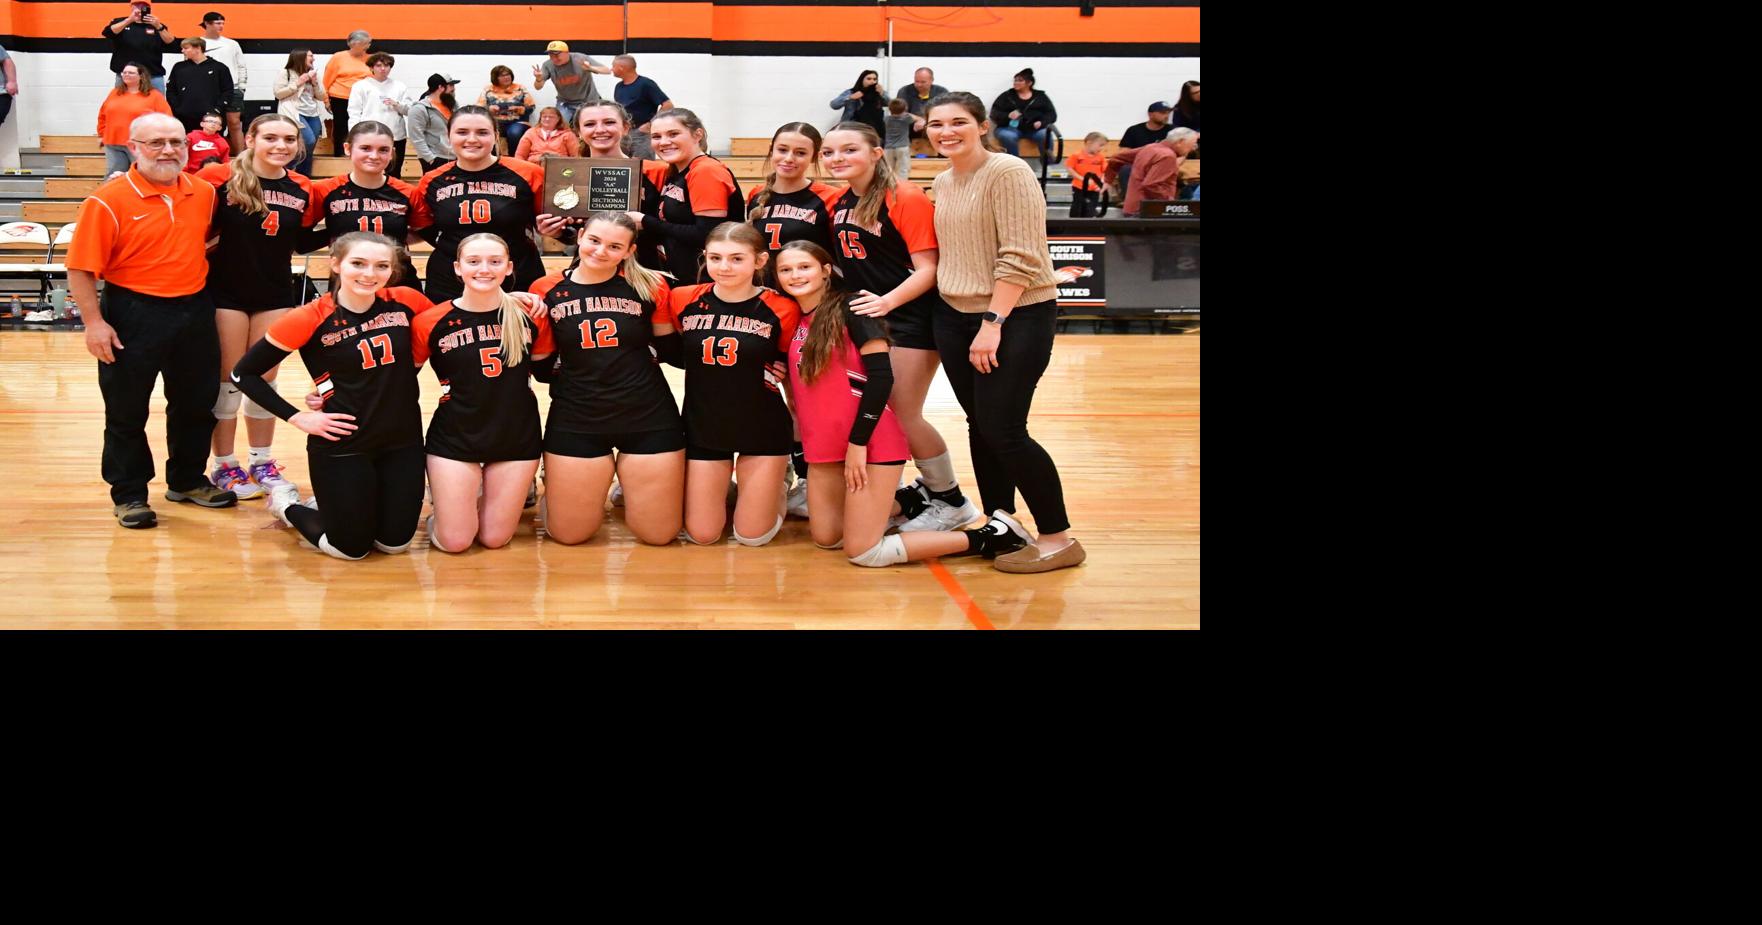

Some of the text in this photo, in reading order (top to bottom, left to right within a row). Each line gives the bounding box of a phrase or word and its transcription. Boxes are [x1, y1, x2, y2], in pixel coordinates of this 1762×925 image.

[436, 181, 517, 202] SOUTH HARRISON
[330, 198, 359, 215] SOUTH
[458, 199, 491, 225] 10
[261, 211, 280, 236] 4
[357, 215, 384, 235] 11
[765, 223, 783, 250] 7
[838, 230, 867, 259] 15
[1049, 245, 1084, 253] SOUTH
[1050, 253, 1093, 261] ARRISON
[1056, 288, 1091, 297] AWKS
[550, 296, 642, 323] SOUTH HARRISON
[320, 327, 358, 347] SOUTH
[578, 318, 619, 349] 12
[682, 314, 715, 332] SOUTH
[716, 315, 773, 339] HARRISON
[356, 333, 395, 370] 17
[438, 327, 475, 354] SOUTH
[701, 336, 739, 367] 13
[479, 346, 503, 378] 5
